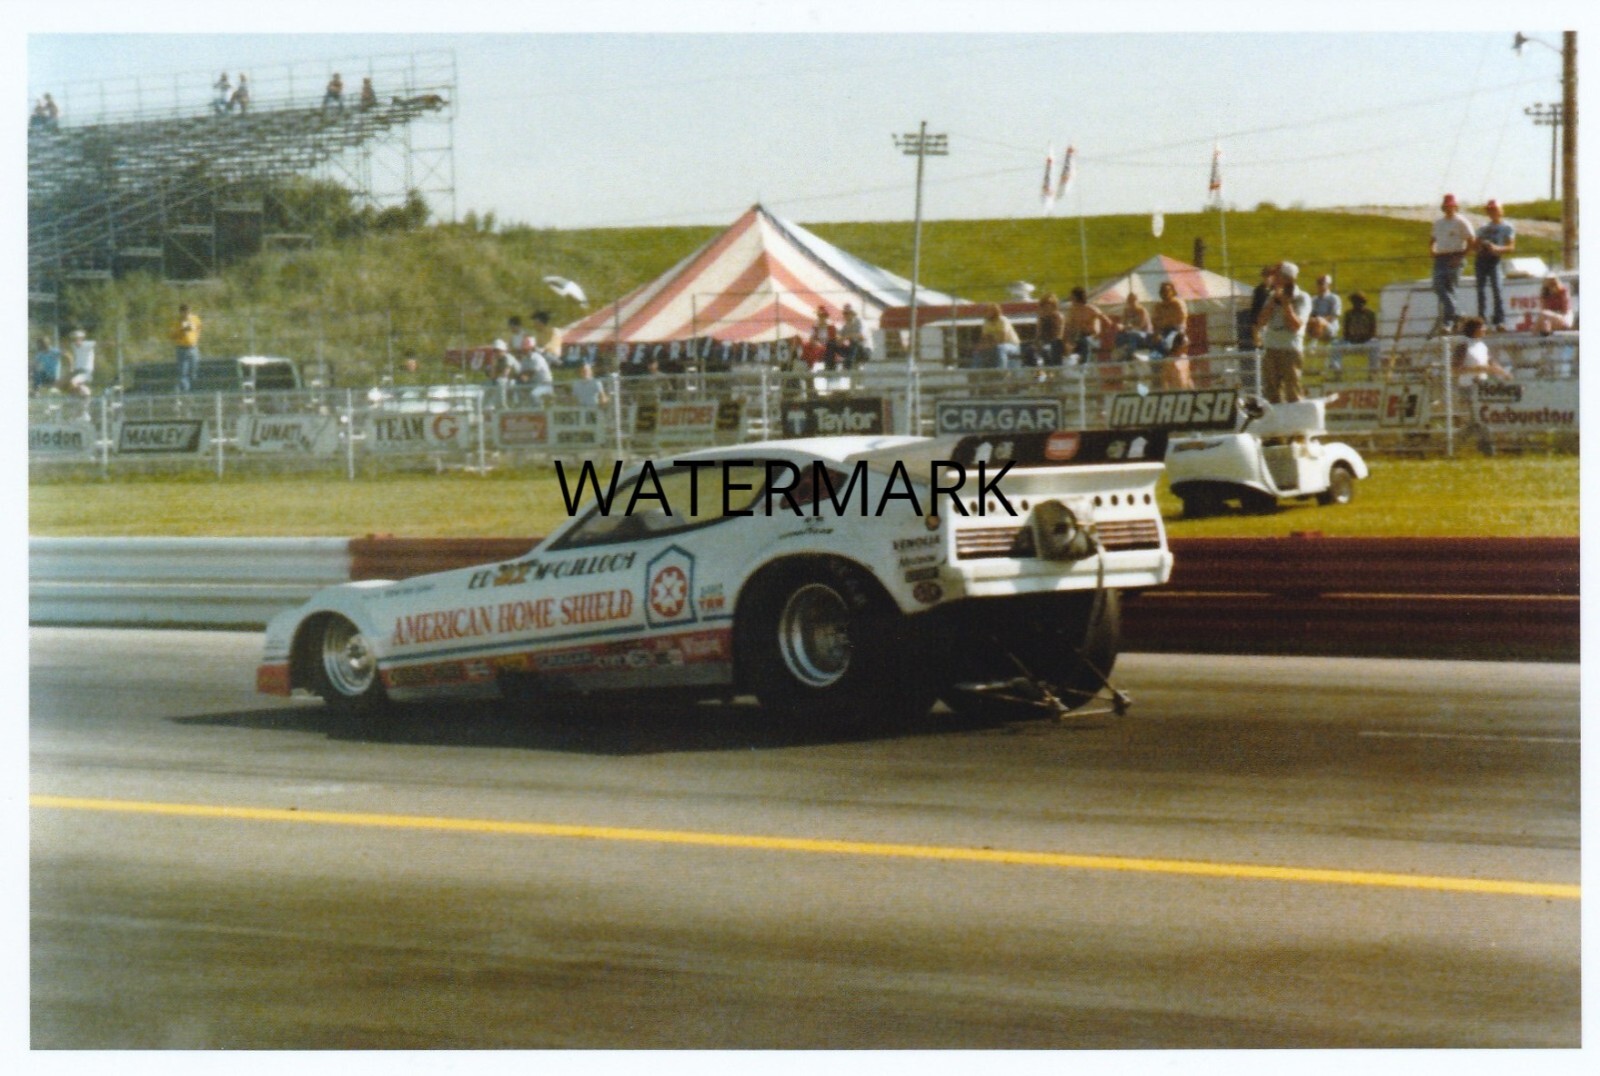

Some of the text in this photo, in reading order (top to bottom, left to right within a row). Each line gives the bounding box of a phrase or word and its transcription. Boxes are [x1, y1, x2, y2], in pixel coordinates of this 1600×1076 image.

[814, 406, 877, 434] Taylor
[940, 408, 1057, 431] CRAGAR
[1111, 391, 1236, 425] MOROSO
[126, 427, 186, 445] MANLEY
[374, 414, 460, 442] TEAM G
[390, 588, 634, 647] AMERICAN HOME SHIELD
